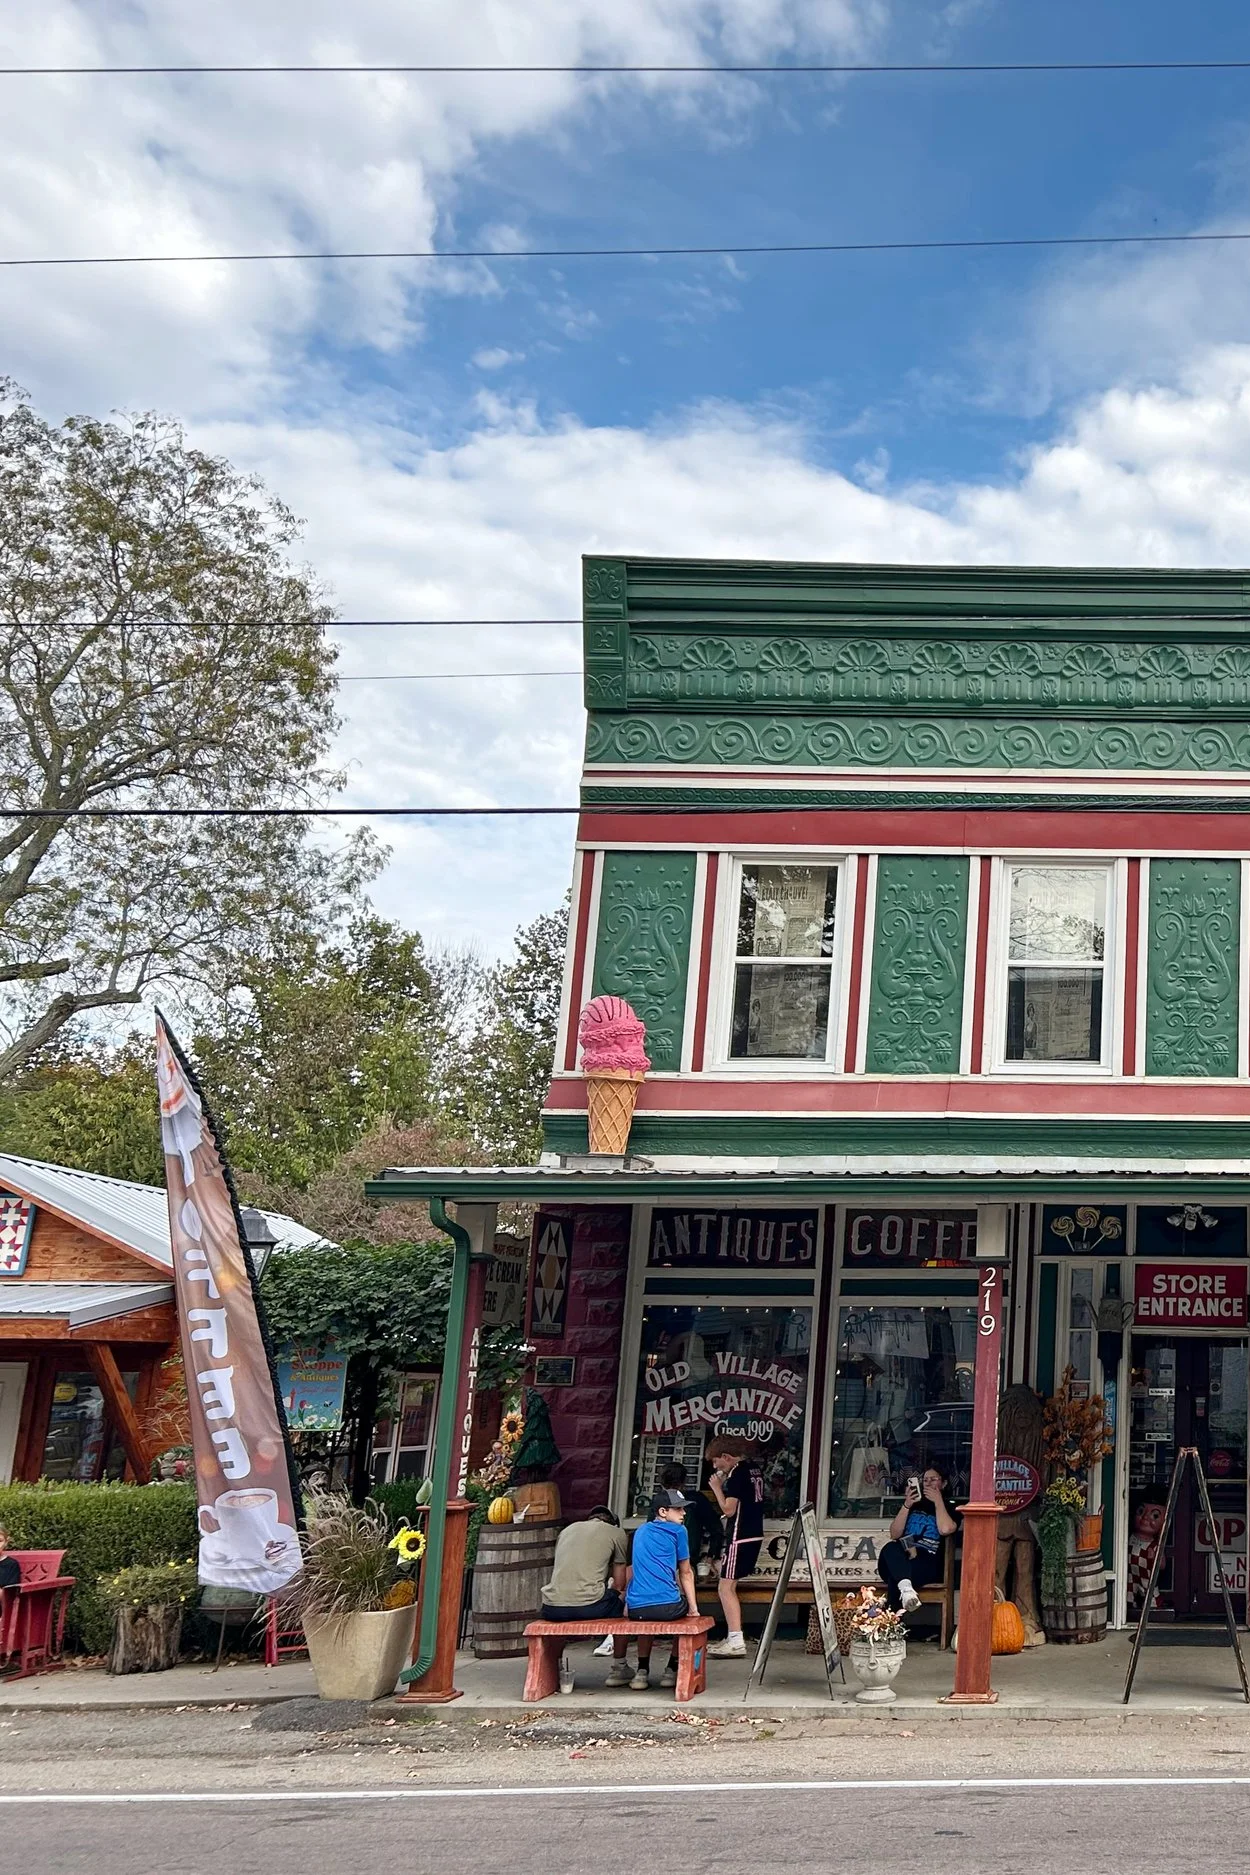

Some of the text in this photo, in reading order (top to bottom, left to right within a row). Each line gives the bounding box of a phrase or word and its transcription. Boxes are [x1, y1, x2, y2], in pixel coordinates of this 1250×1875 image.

[652, 1214, 815, 1262] ANTIQUES
[851, 1215, 977, 1261] COFFE
[496, 1261, 522, 1284] CREAM
[1152, 1274, 1227, 1294] STORE
[483, 1291, 497, 1312] ERE
[980, 1267, 997, 1336] 219
[1138, 1297, 1243, 1317] ENTRANCE
[645, 1352, 803, 1394] OLD VILLAGE
[456, 1328, 480, 1498] ANTIQUES
[644, 1387, 803, 1433] MERCANTILE
[745, 1420, 773, 1442] 1909
[996, 1480, 1032, 1492] CANTILE
[1197, 1518, 1246, 1546] OP
[766, 1535, 877, 1561] CEA
[802, 1567, 863, 1576] SAKES
